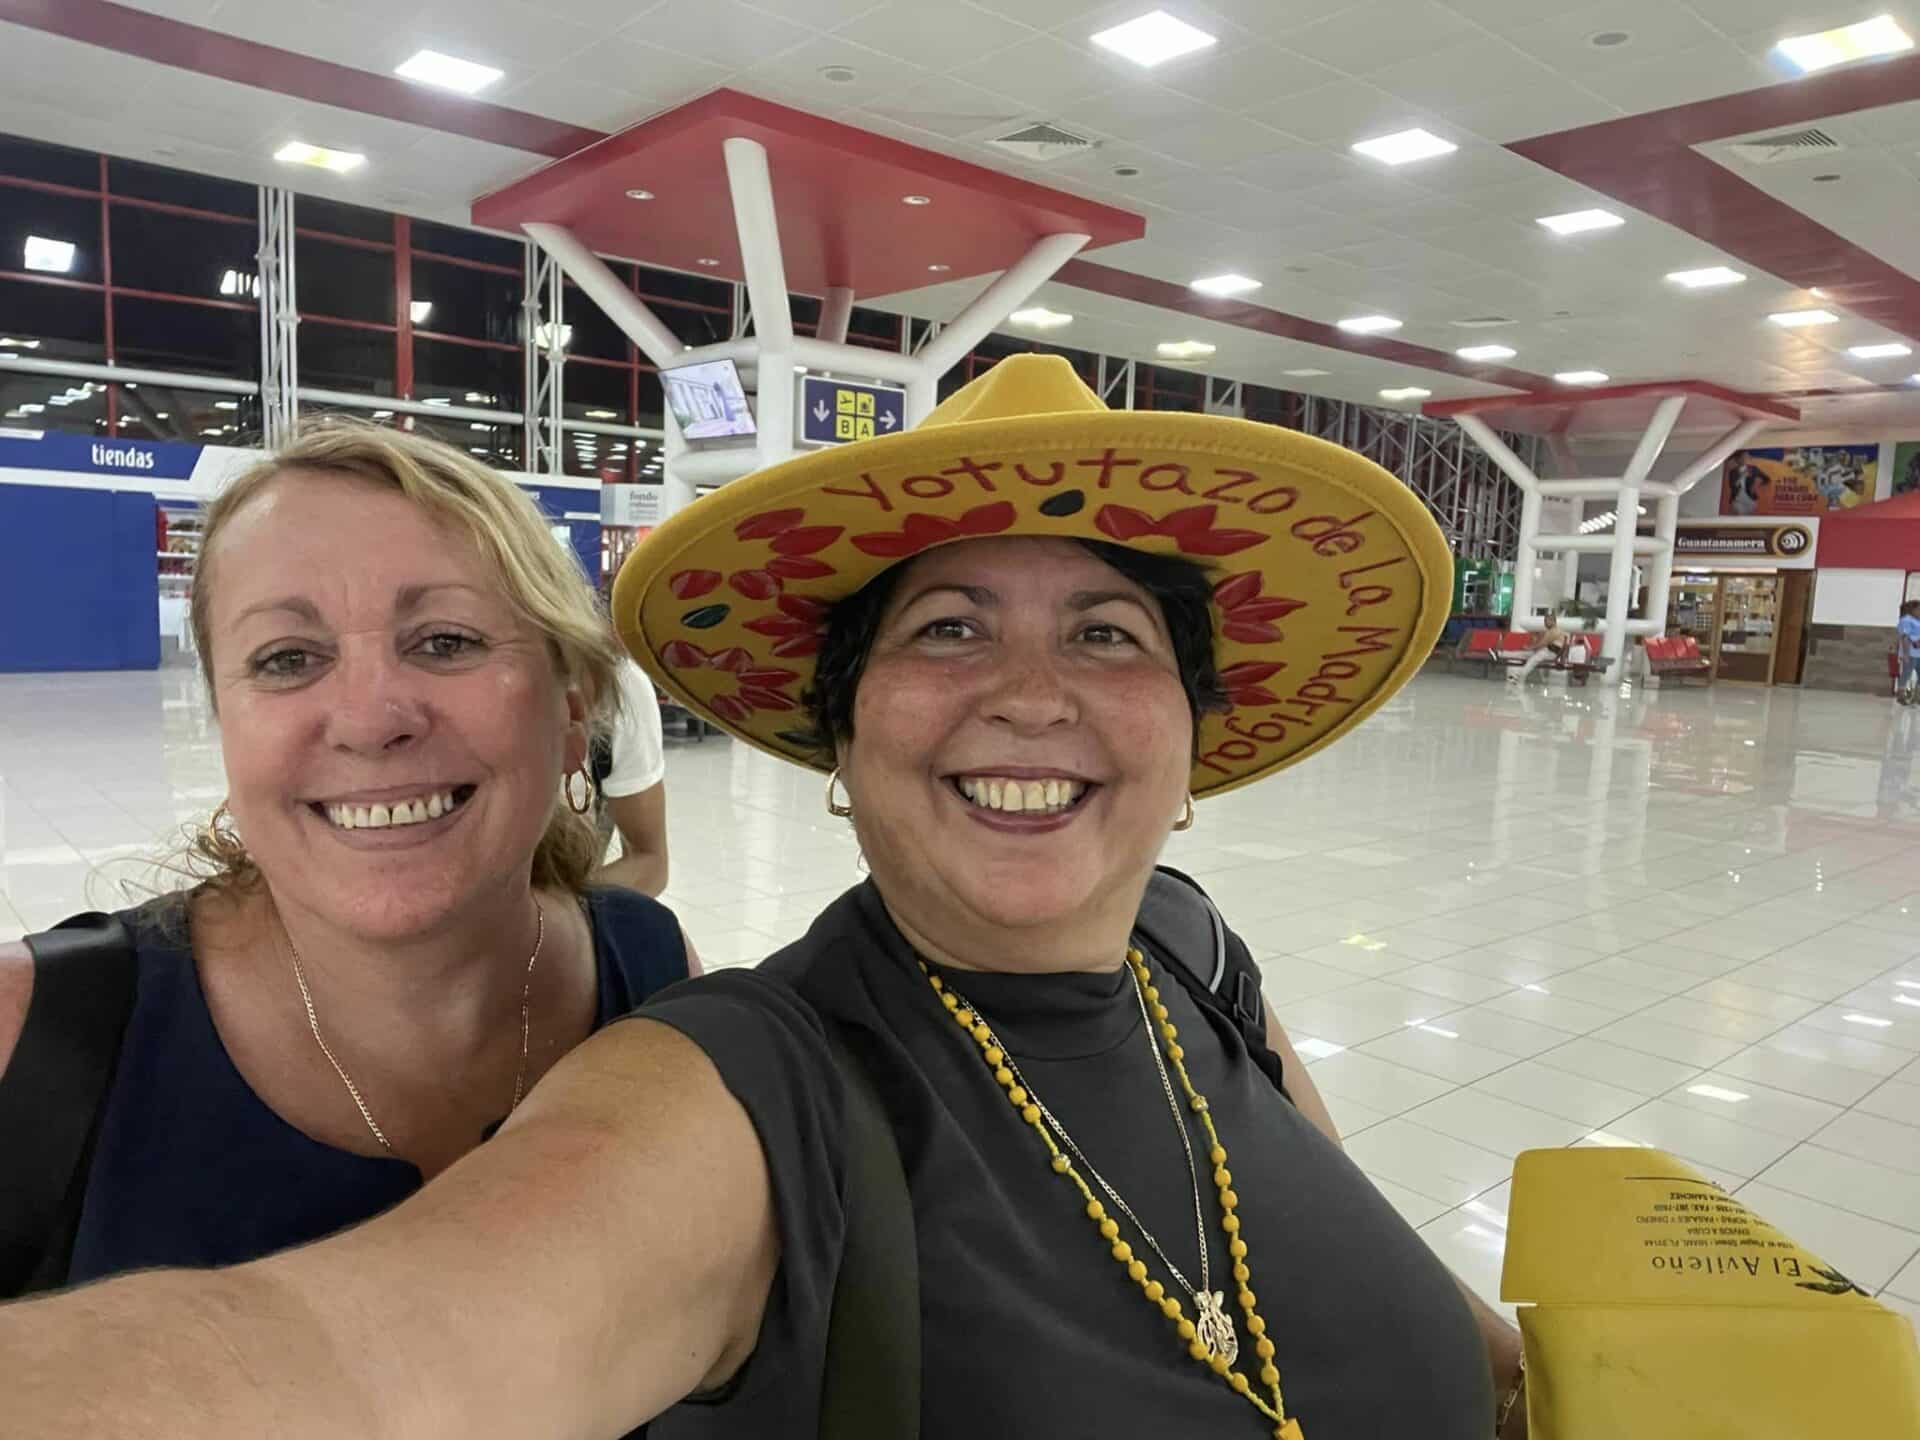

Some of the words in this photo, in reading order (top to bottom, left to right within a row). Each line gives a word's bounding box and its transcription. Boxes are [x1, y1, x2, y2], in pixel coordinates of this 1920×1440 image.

[841, 419, 850, 435] B
[861, 422, 870, 437] A
[91, 443, 154, 468] tiendas
[1290, 510, 1377, 557] de
[1338, 556, 1408, 616] La
[1652, 1255, 1760, 1276] Avileño
[1772, 1257, 1801, 1277] El
